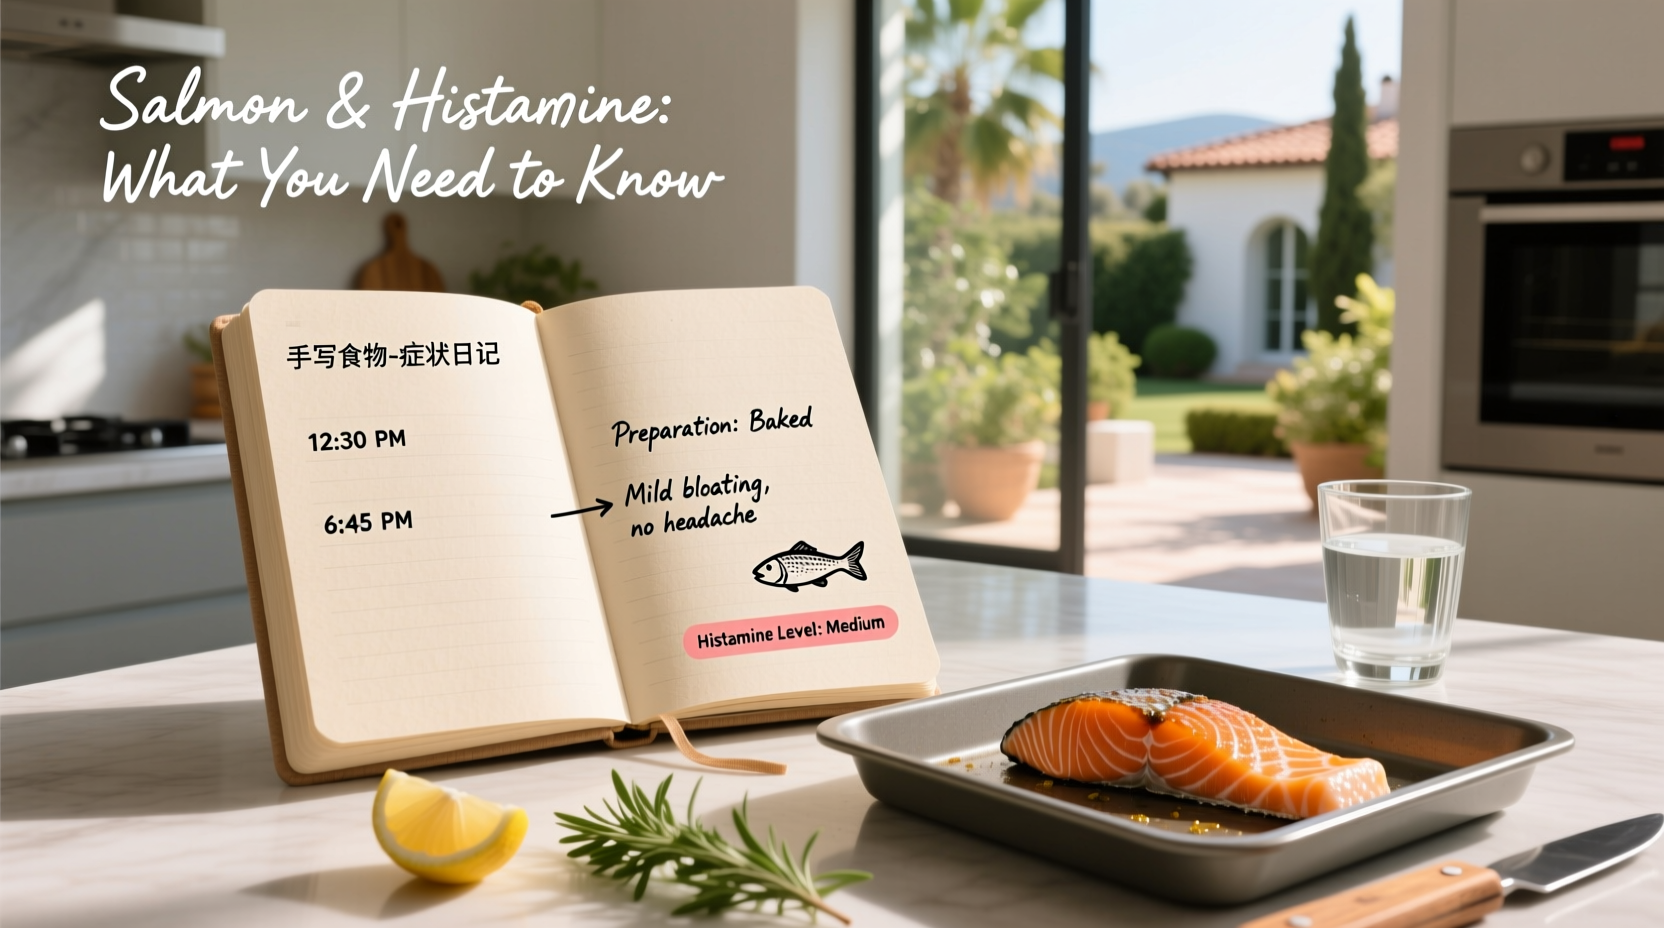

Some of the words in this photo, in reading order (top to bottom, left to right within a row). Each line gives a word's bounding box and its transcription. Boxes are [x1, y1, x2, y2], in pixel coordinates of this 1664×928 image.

[286, 341, 500, 370] 手写食物-症状日记
[308, 430, 367, 452] 12:30
[374, 429, 406, 448] PM
[611, 415, 738, 453] Preparation:
[749, 405, 813, 433] Baked
[624, 478, 673, 508] Mild
[682, 473, 770, 504] bloating,
[324, 512, 373, 535] 6:45
[381, 510, 413, 531] PM
[630, 522, 655, 538] no
[663, 502, 759, 533] headache
[697, 627, 774, 649] Histamine
[777, 621, 822, 641] Level:
[826, 615, 886, 635] Medium
